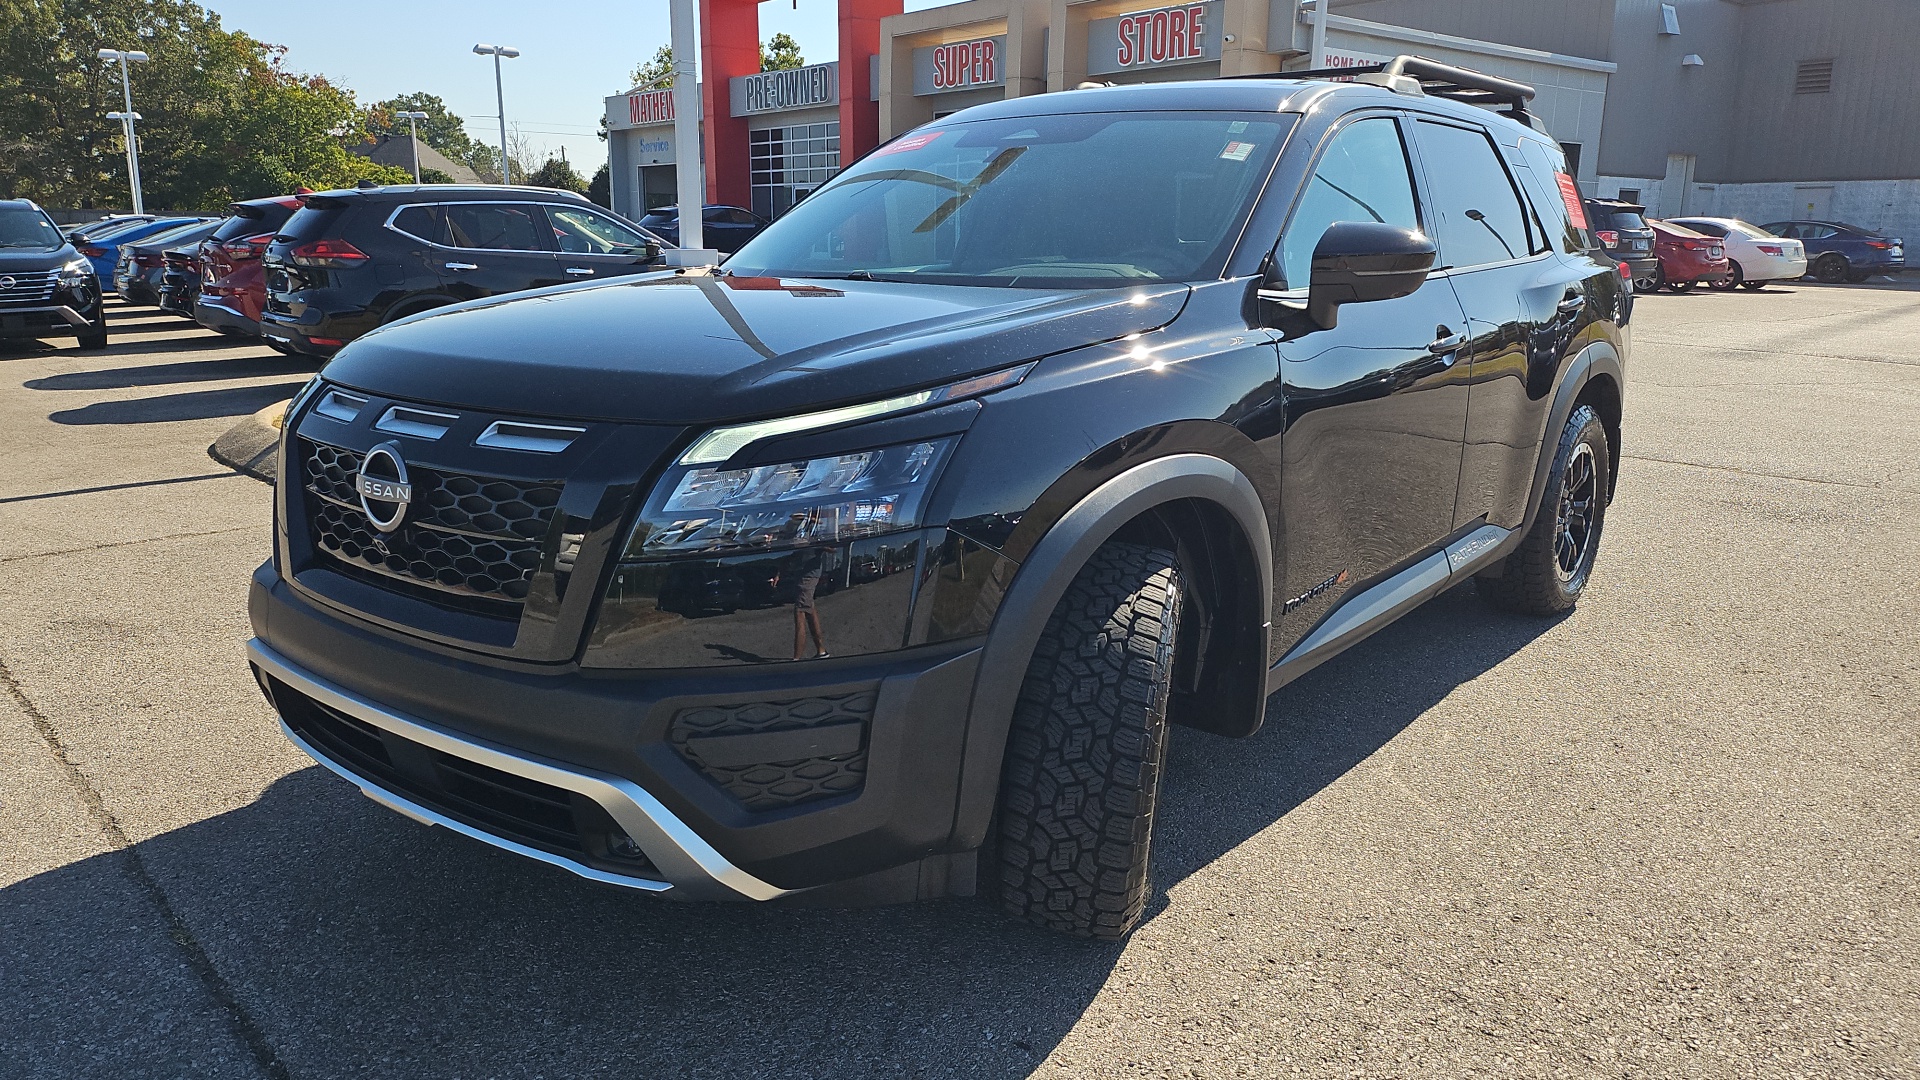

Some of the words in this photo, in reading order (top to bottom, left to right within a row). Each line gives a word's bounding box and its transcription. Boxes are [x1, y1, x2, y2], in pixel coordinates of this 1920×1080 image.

[1117, 6, 1204, 67] STORE
[933, 40, 995, 89] SUPER
[1325, 54, 1354, 68] HOME
[745, 66, 829, 111] PRE-OWNED
[640, 137, 669, 153] Service
[1450, 529, 1499, 566] PATHFINDER
